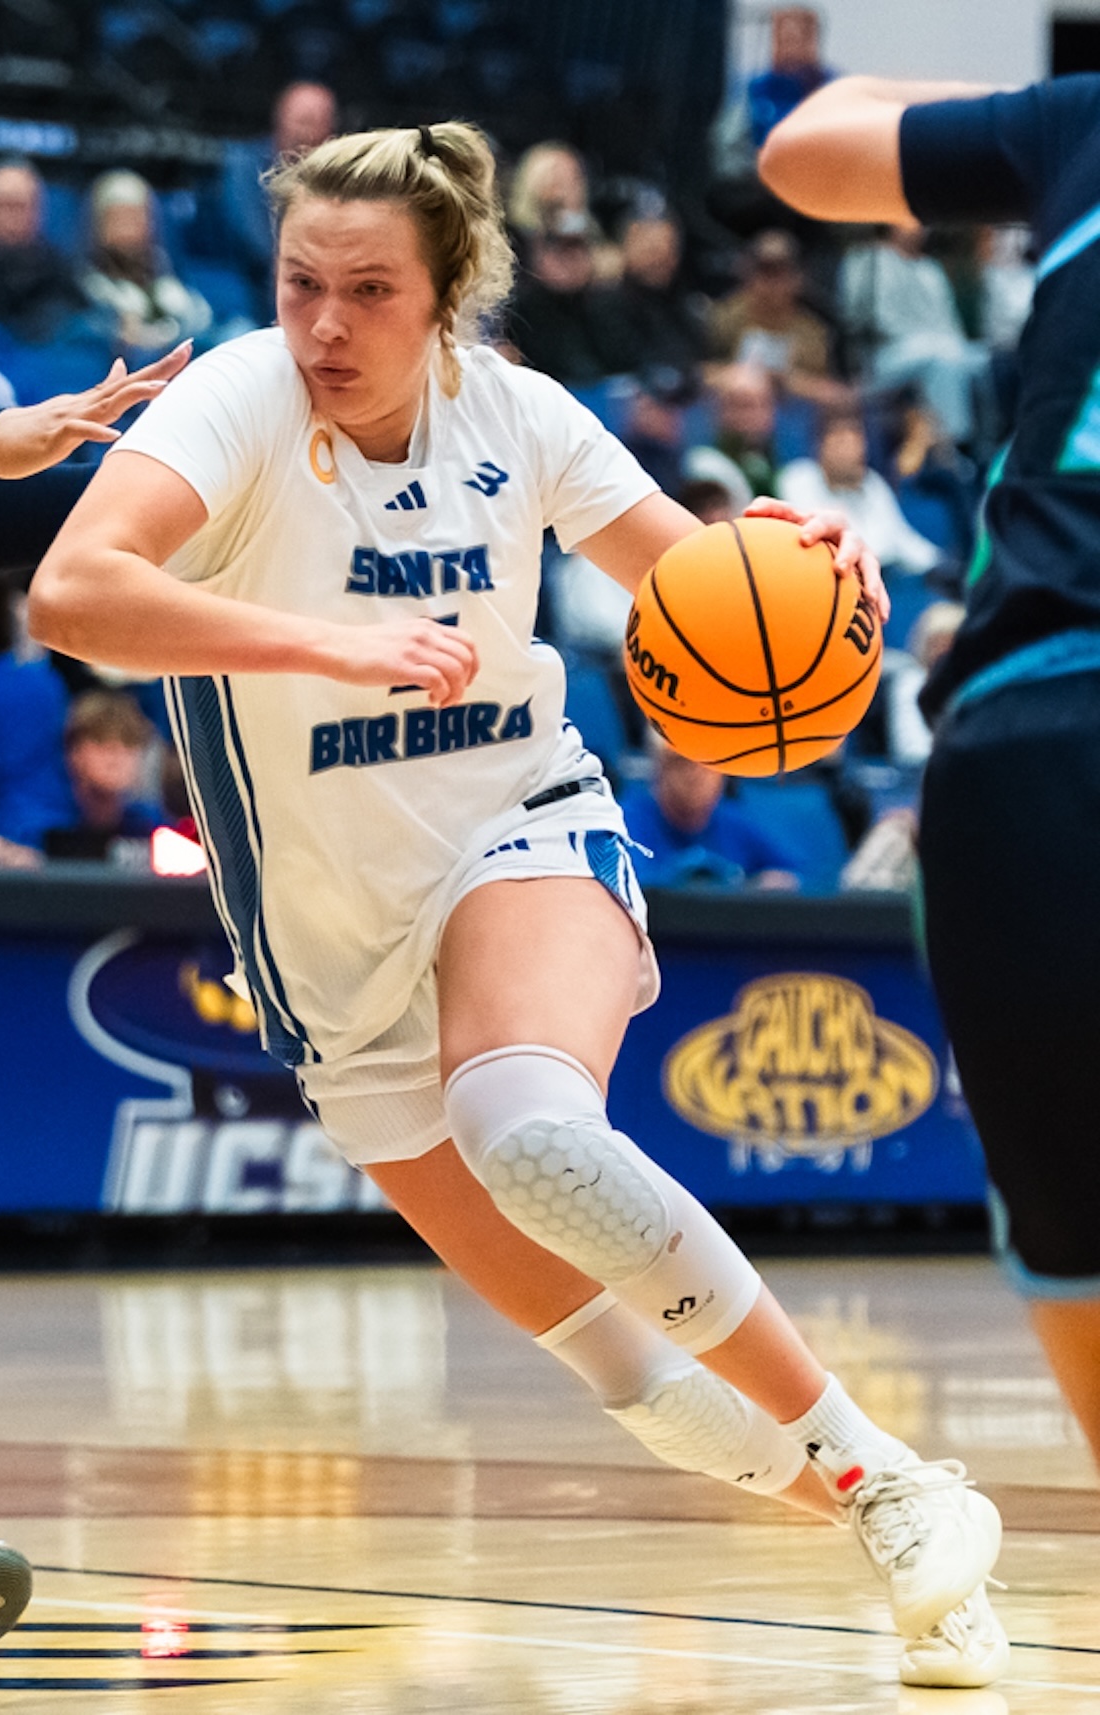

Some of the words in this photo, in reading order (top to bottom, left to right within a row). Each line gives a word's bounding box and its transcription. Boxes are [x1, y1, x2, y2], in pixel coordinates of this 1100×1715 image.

[344, 543, 496, 599] SANTA
[308, 695, 534, 776] BARBARA
[120, 1120, 397, 1214] UCS
